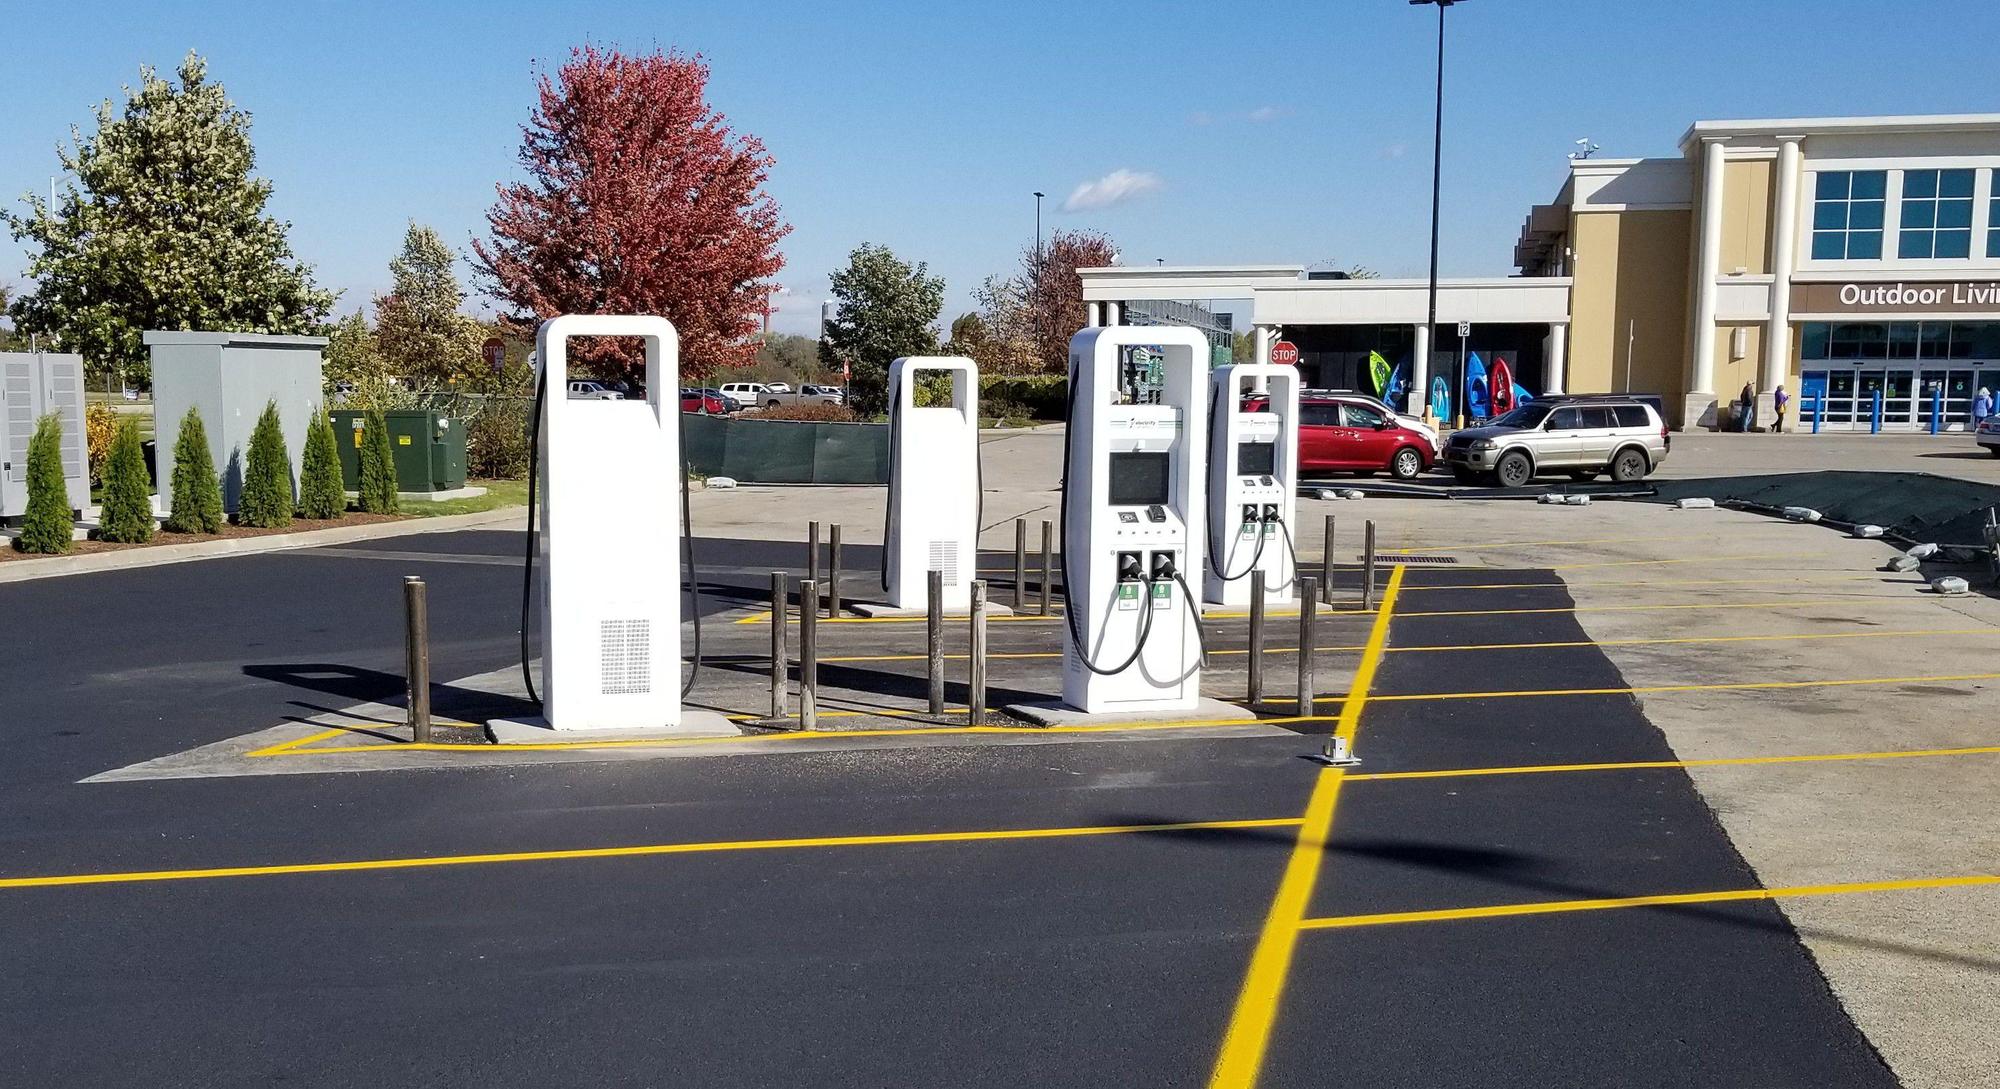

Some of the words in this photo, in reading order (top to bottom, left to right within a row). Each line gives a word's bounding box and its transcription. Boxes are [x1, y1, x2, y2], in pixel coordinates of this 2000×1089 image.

[1840, 283, 1946, 304] Outdoor
[1460, 325, 1469, 335] 12
[1273, 350, 1296, 360] STOP
